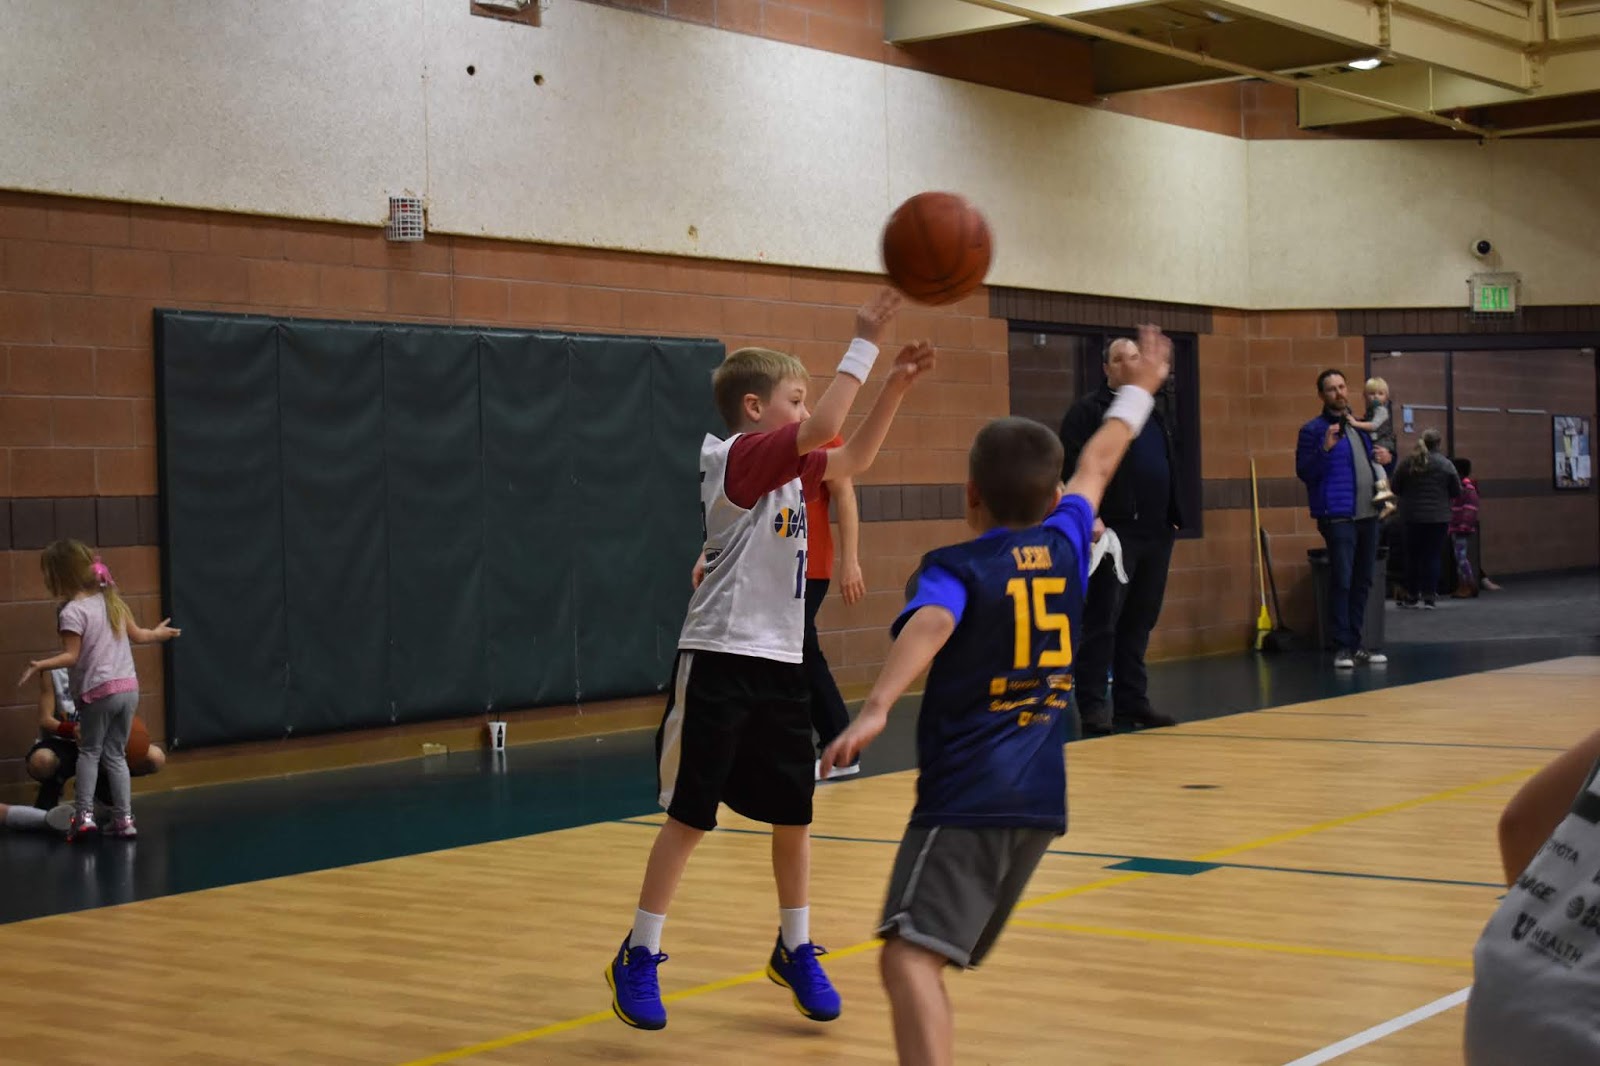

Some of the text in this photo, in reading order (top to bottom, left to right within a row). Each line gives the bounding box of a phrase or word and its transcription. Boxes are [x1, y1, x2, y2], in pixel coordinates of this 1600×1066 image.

[1481, 287, 1509, 309] EXIT
[794, 550, 807, 599] 1
[1005, 577, 1073, 669] 15
[1532, 928, 1583, 963] HEALTH
